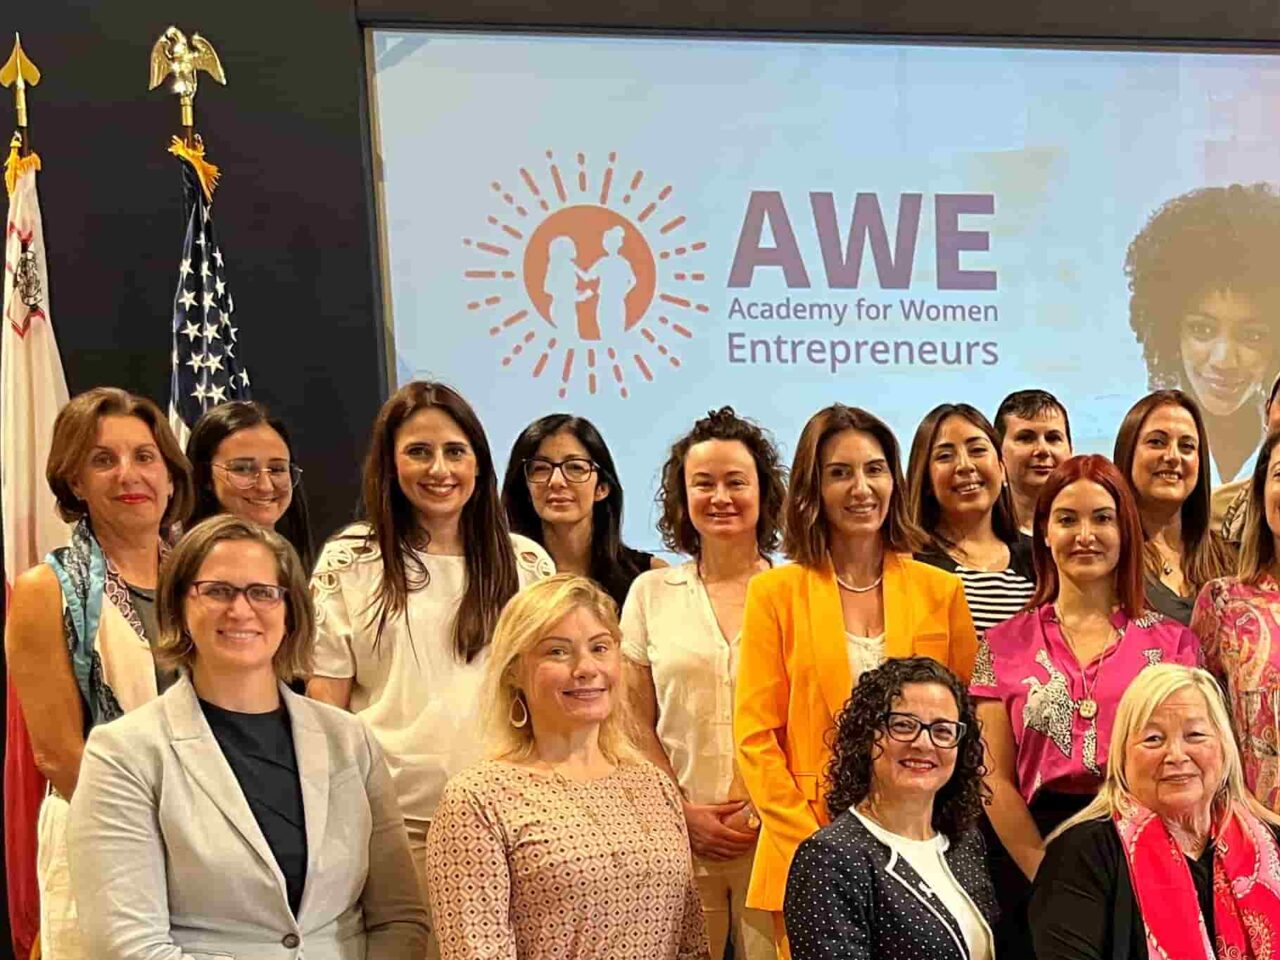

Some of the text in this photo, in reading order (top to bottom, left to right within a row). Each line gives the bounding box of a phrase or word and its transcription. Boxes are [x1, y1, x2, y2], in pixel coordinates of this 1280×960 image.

[726, 190, 998, 290] AWE
[728, 297, 998, 326] Academy for Women
[728, 332, 998, 374] Entrepreneurs
